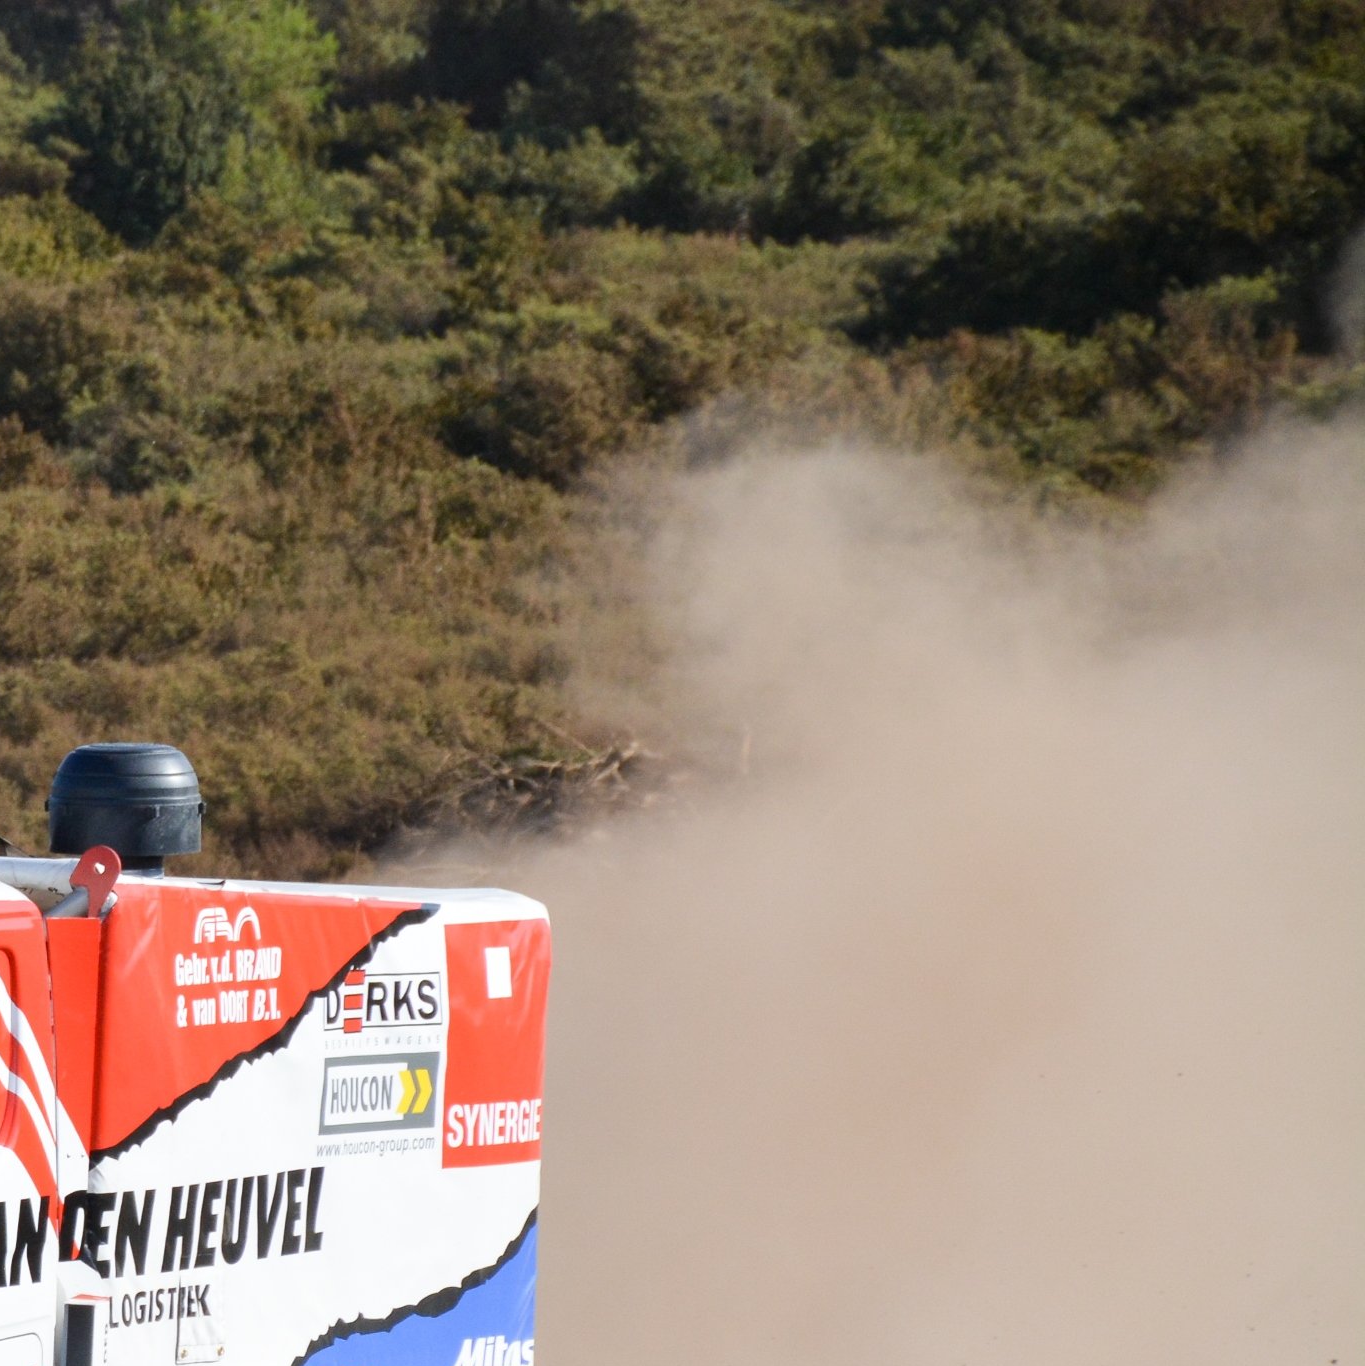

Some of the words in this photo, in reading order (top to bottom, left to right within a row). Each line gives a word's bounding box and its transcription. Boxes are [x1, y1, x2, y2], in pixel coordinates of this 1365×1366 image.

[175, 952, 210, 987] Gebr.
[211, 949, 233, 983] v.d.
[235, 946, 282, 982] BRAND
[177, 993, 188, 1028] &
[192, 997, 217, 1026] van
[219, 989, 249, 1024] OORT
[326, 969, 439, 1034] DERKS
[330, 1075, 394, 1114] HOUCON
[446, 1098, 542, 1148] SYNERGIE
[316, 1135, 435, 1158] www.houcon-group.com
[57, 1188, 157, 1280] DEN
[160, 1166, 325, 1273] HEUVEL
